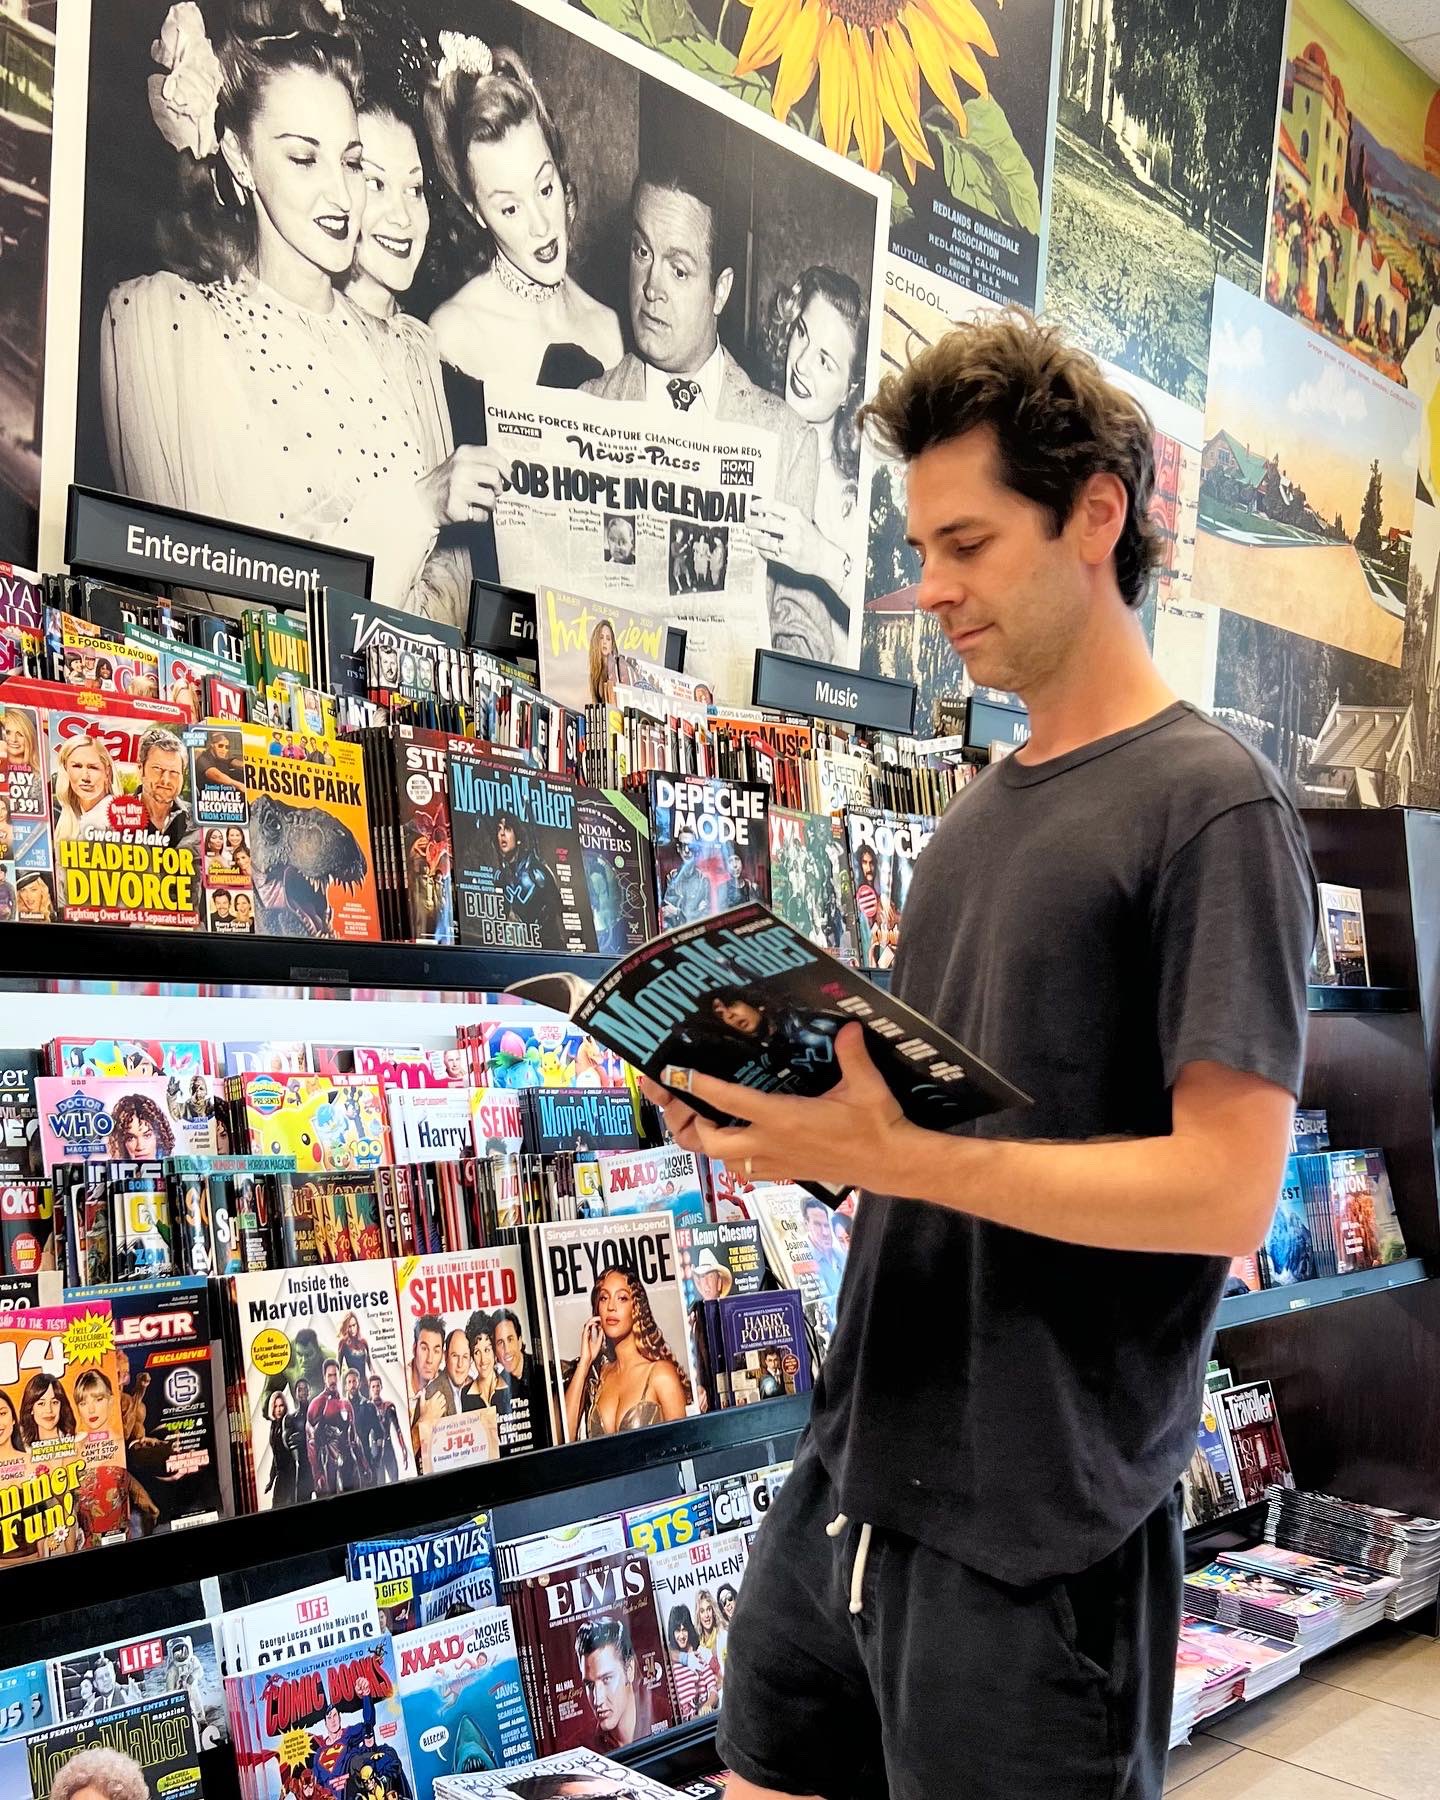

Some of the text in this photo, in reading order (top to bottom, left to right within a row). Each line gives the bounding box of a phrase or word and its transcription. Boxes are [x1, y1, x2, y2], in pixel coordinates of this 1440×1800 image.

[932, 200, 1020, 255] REDLANDS ORANGEDALE
[951, 227, 1000, 261] ASSOCIATION
[892, 242, 971, 288] MUTUAL ORANGE
[928, 233, 1019, 286] REDLANDS, CALIFORNIA
[948, 257, 970, 275] GROWN
[972, 268, 980, 278] IN
[885, 271, 949, 314] SCHOOL.
[487, 406, 762, 458] CHIANG FORCES RECAPTURE CHANGCHUN FROM REDS
[499, 424, 541, 437] WEATHER
[565, 434, 701, 472] News-Press
[721, 460, 754, 473] HOME
[721, 472, 754, 485] FINAL
[502, 459, 549, 499] OB
[552, 466, 620, 510] HOPE
[624, 477, 648, 511] IN
[651, 480, 762, 523] GLENDAL
[126, 524, 321, 591] Entertainment
[69, 636, 152, 662] 5 FOODS TO AVOID
[216, 683, 241, 714] TV
[815, 681, 858, 709] Music
[54, 714, 145, 764] Star
[448, 739, 475, 755] SFX
[244, 755, 301, 771] ULTIMATE
[307, 766, 340, 778] GUIDE
[200, 791, 241, 802] MIRACLE
[246, 765, 361, 806] RASSIC PARK
[451, 763, 575, 830] MovieMaker
[548, 784, 572, 793] magazine
[199, 801, 245, 814] RECOVERY
[656, 779, 764, 820] DEPECHE
[200, 812, 243, 821] FROM STROKE
[673, 809, 749, 846] MODE
[84, 826, 171, 847] Gwen & Blake
[60, 840, 196, 876] HEADED FOR
[67, 868, 194, 912] DIVORCE
[66, 908, 200, 926] Fighting Over Kids & Separate Lives!
[465, 891, 506, 921] BLUE
[482, 920, 542, 949] BEETLE
[589, 925, 818, 1065] MovieMaker
[58, 1098, 102, 1113] DOCTOR
[538, 1096, 633, 1138] MovieMaker
[48, 1111, 114, 1138] WHO
[418, 1121, 466, 1148] Harry
[65, 1144, 106, 1154] MAGAZINE
[247, 1160, 270, 1171] HORROR
[270, 1160, 297, 1171] MAGAZINE
[610, 1153, 693, 1194] MAD MOVIE
[659, 1165, 694, 1181] CLASSICS
[2, 1187, 36, 1215] OK!
[546, 1220, 669, 1240] Singer. Icon. Artist. Legend.
[680, 1212, 704, 1228] JAWS
[781, 1220, 797, 1233] Chip
[692, 1227, 718, 1248] Kenny
[718, 1223, 757, 1244] Chesney
[784, 1240, 809, 1251] Joanna
[422, 1258, 500, 1276] THE ULTIMATE GUIDE TO
[548, 1232, 676, 1298] BEYONCE
[789, 1252, 814, 1263] Gaines
[288, 1273, 349, 1294] Inside the
[410, 1268, 518, 1318] SEINFELD
[248, 1290, 389, 1323] Marvel Universe
[16, 1316, 67, 1330] TO THE TEST!
[113, 1311, 196, 1343] LECTR
[744, 1311, 785, 1330] HARRY
[742, 1324, 791, 1342] POTTER
[152, 1349, 207, 1365] EXCLUSIVE!
[510, 1398, 529, 1409] The
[497, 1408, 530, 1423] reatest
[499, 1420, 532, 1434] Sitcom
[31, 1436, 75, 1448] SECRETS YOU
[99, 1439, 114, 1447] SHE
[507, 1431, 533, 1443] Time
[1234, 1437, 1256, 1456] HOT
[31, 1453, 55, 1463] ABOUT
[32, 1443, 75, 1455] NEVER KNEW
[81, 1446, 118, 1457] CAN'T STOP
[1237, 1452, 1259, 1471] LIST
[0, 1492, 76, 1554] Fun!
[630, 1508, 693, 1556] BTS
[358, 1526, 490, 1583] HARRY STYLES
[690, 1545, 710, 1564] LIFE
[666, 1556, 740, 1595] VAN HALEN
[382, 1580, 409, 1598] GIFTS
[456, 1578, 492, 1602] STYLES
[545, 1561, 646, 1621] ELVIS
[297, 1596, 329, 1624] LIFE
[259, 1610, 370, 1650] George Lucas and the Making of
[400, 1619, 509, 1677] MAD MOVIE
[467, 1631, 511, 1653] CLASSICS
[120, 1641, 163, 1673] LIFE
[286, 1650, 364, 1677] THE ULTIMATE GUIDE TO
[265, 1655, 394, 1737] COMIC BOOKS
[495, 1681, 520, 1700] JAWS
[28, 1695, 186, 1745] FILM FESTIVALS WORTH THE ENTRY FEE
[152, 1706, 186, 1720] magazine
[497, 1704, 524, 1720] SCARFACE
[503, 1741, 532, 1759] GREASE
